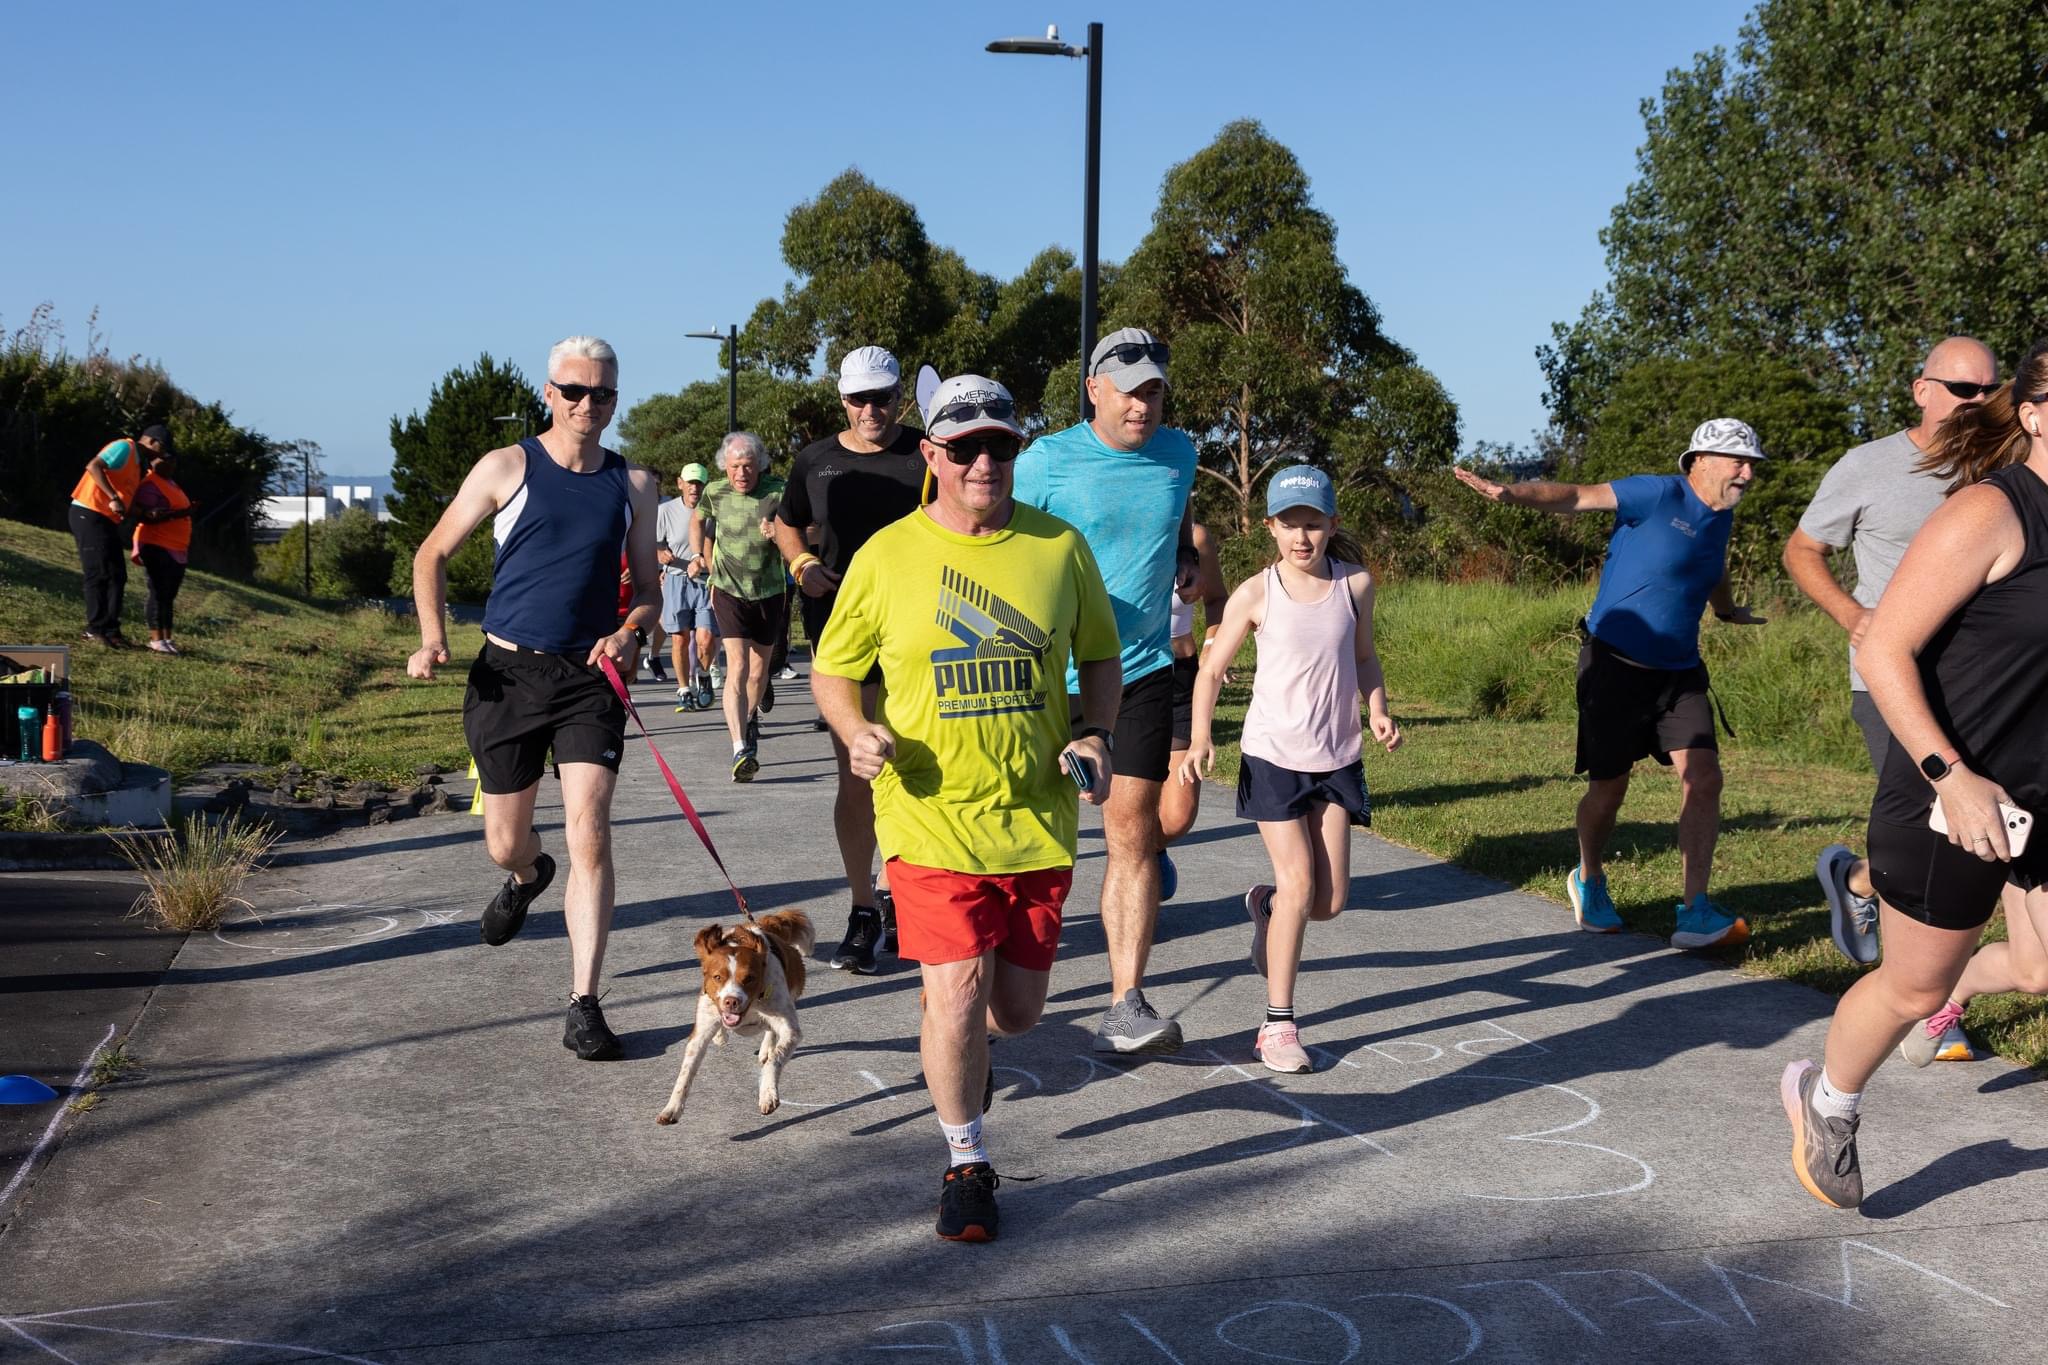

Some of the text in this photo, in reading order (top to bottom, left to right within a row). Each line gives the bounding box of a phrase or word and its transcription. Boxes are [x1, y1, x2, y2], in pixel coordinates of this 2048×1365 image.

[934, 659, 1033, 697] PUMA
[938, 694, 1032, 711] PREMIUM SPORTS
